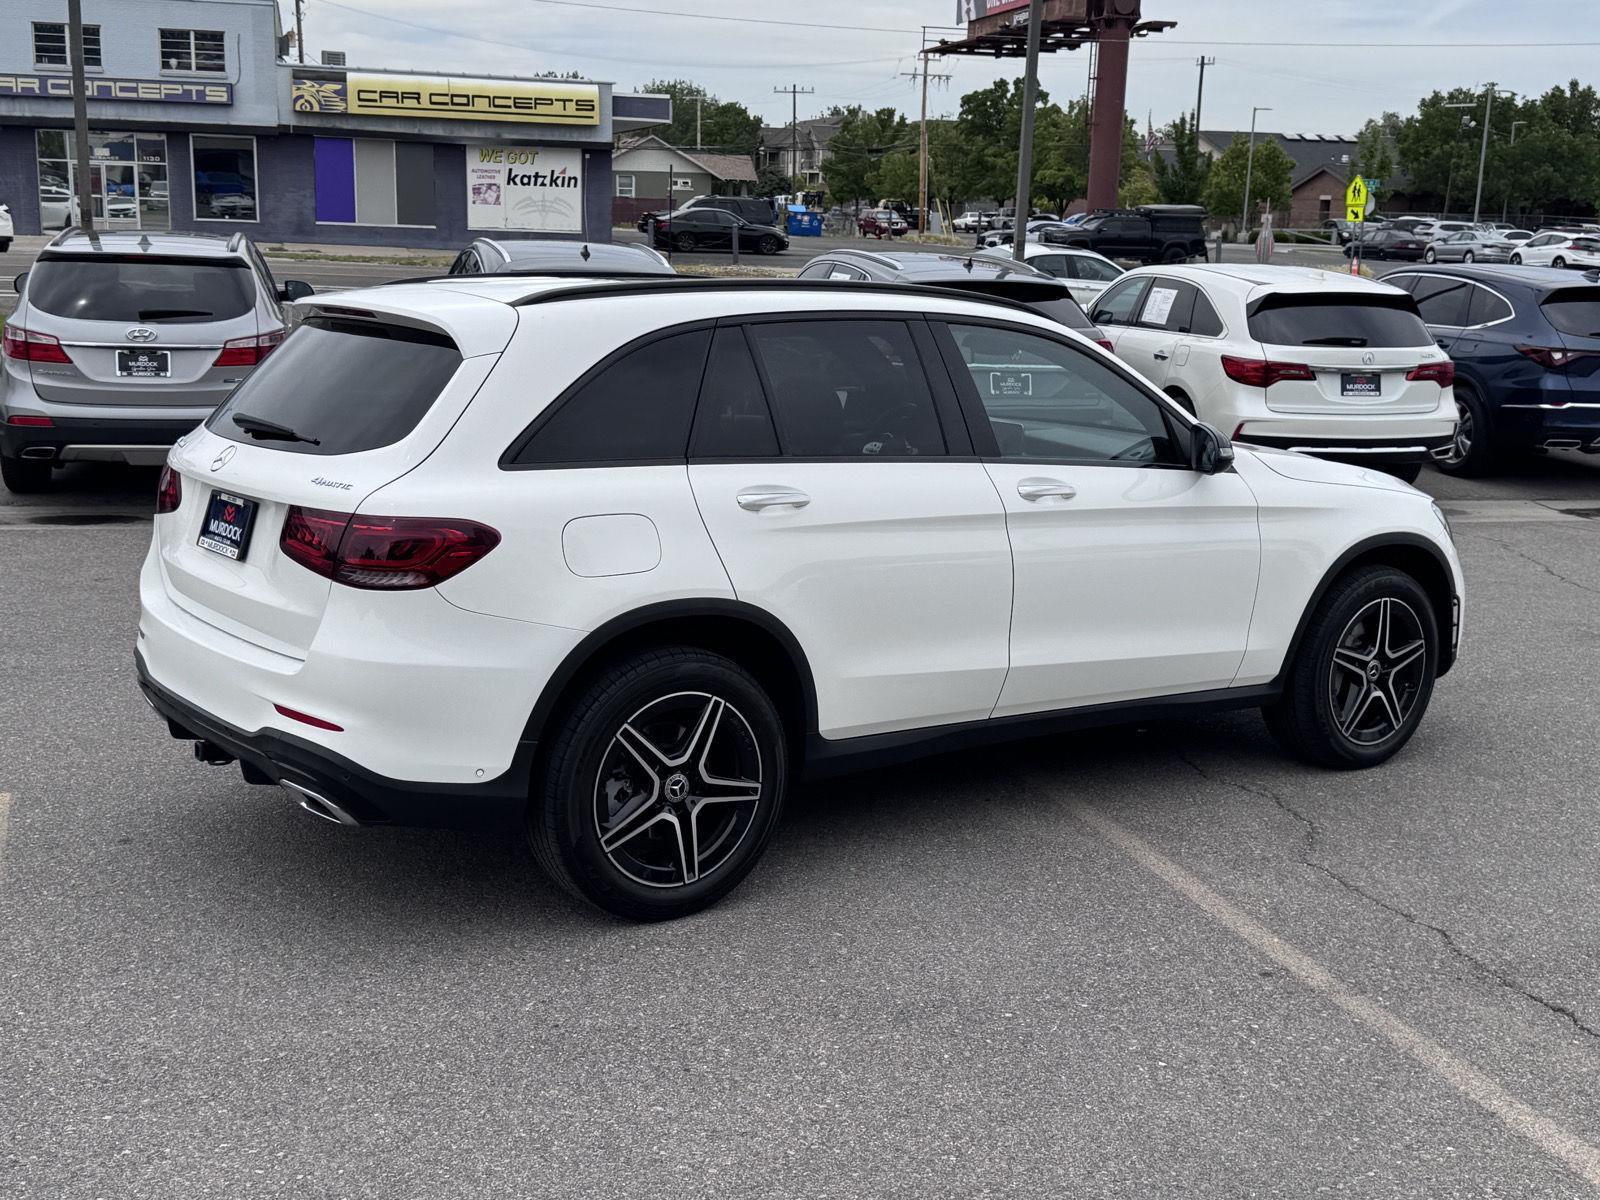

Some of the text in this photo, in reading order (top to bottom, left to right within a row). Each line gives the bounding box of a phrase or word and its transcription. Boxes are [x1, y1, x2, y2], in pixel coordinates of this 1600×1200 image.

[0, 76, 40, 94] AR
[357, 89, 595, 112] CAR CONCEPTS
[479, 149, 539, 166] WE GOT
[506, 166, 579, 189] katzkin
[209, 518, 243, 542] MURDOCK
